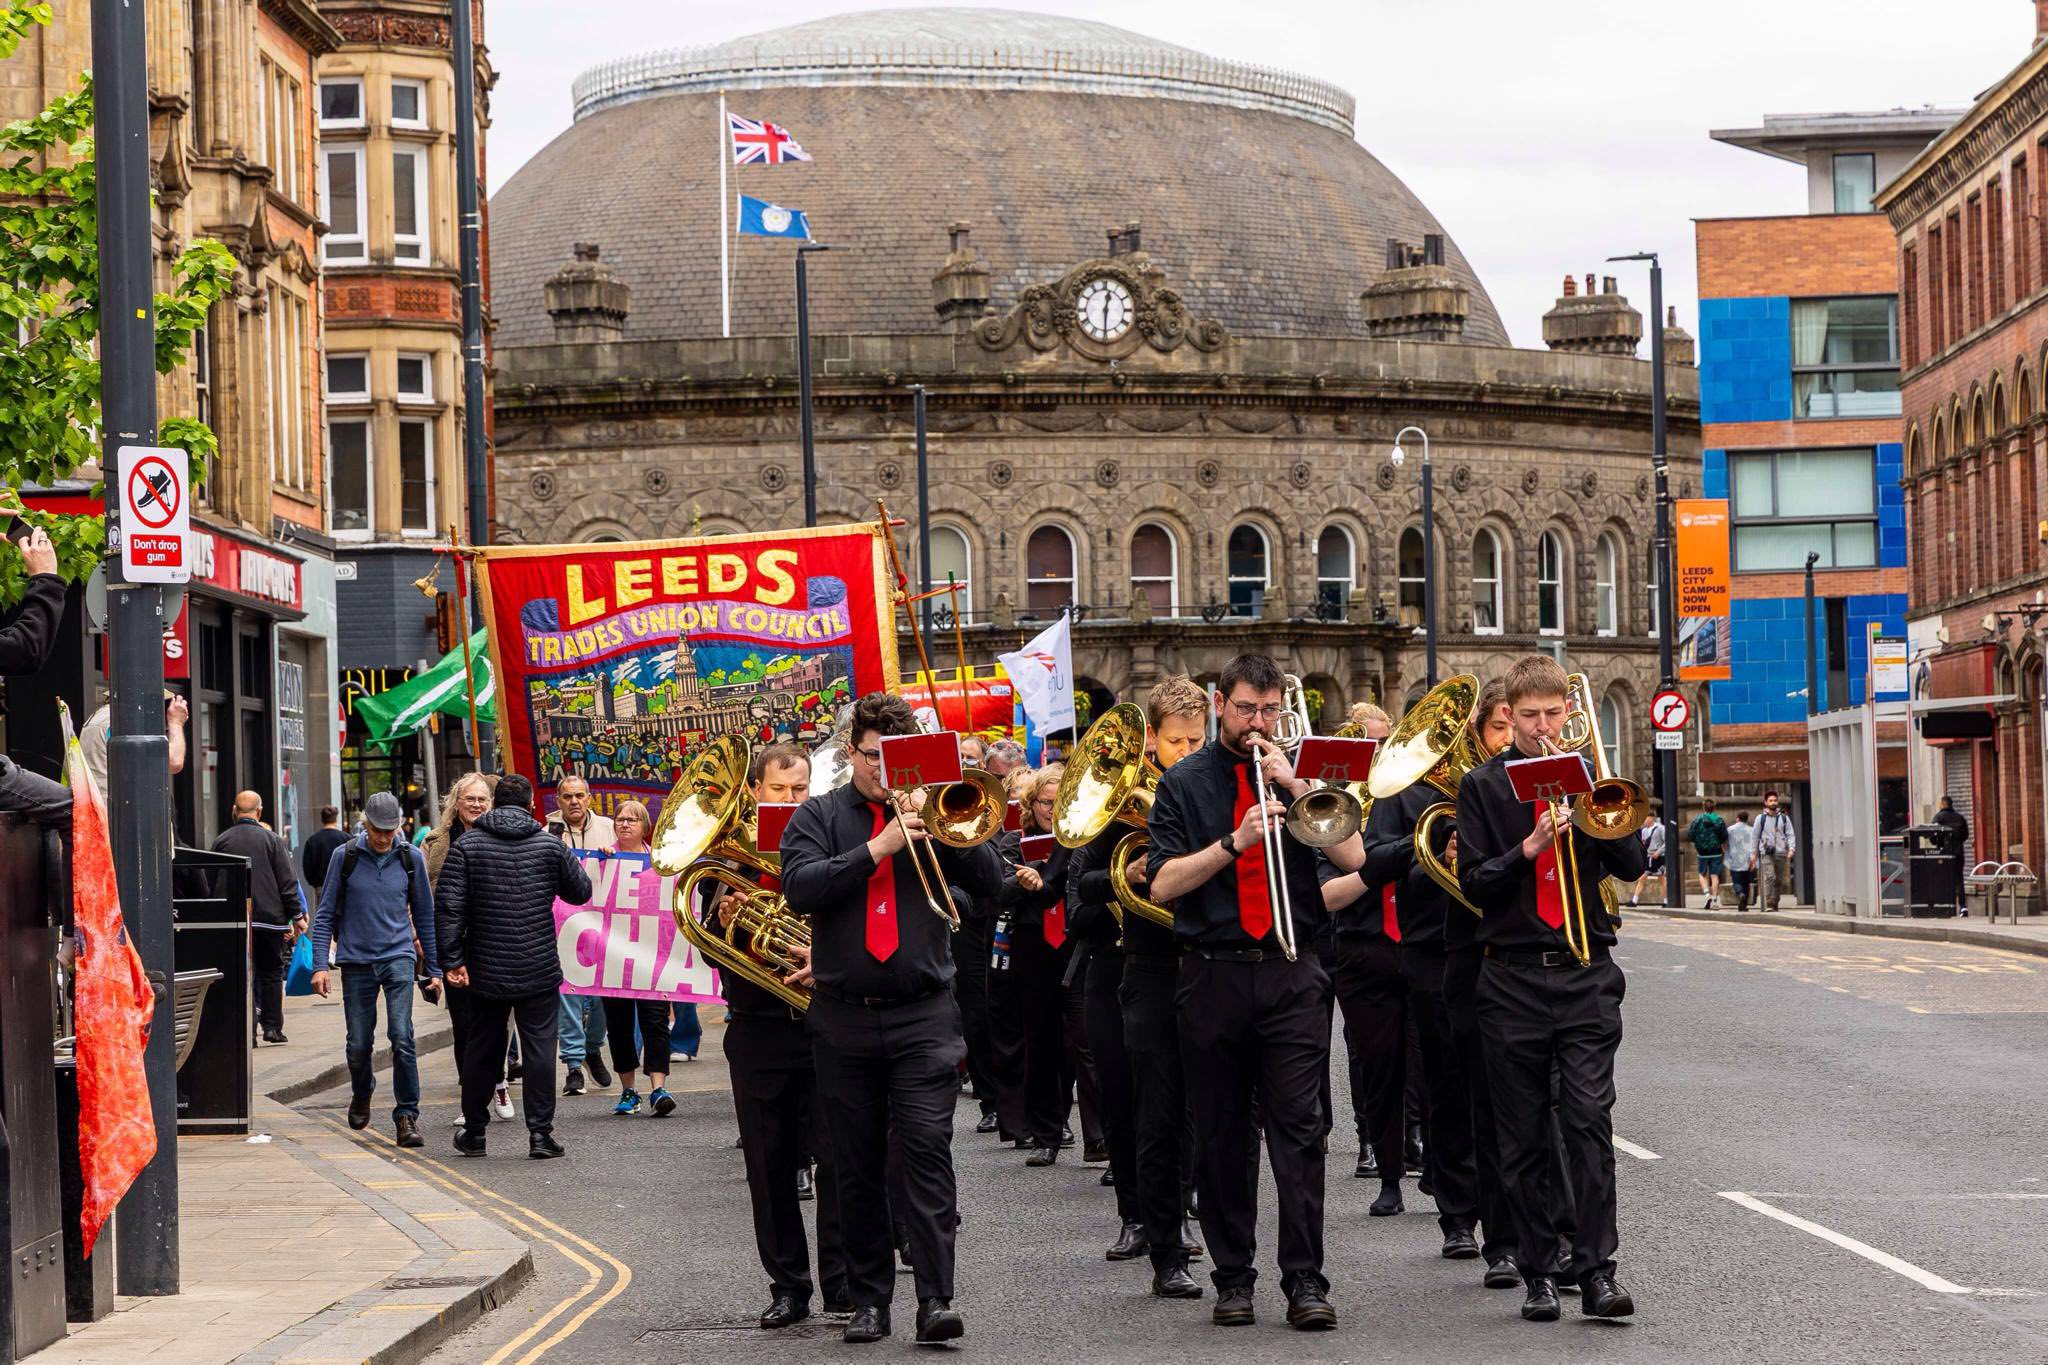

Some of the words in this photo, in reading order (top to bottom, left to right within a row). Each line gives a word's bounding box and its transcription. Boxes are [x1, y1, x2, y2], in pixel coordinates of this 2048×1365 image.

[133, 538, 157, 550] Don't
[158, 539, 178, 553] drop
[147, 552, 166, 564] gum
[1682, 567, 1714, 576] LEEDS
[1682, 577, 1706, 585] CITY
[566, 549, 798, 625] LEEDS
[1682, 586, 1726, 594] CAMPUS
[1683, 595, 1708, 604] NOW
[1683, 604, 1711, 613] OPEN
[528, 620, 624, 662] TRADES
[629, 605, 718, 637] UNION
[728, 606, 847, 639] COUNCIL
[1764, 760, 1790, 772] TRUE
